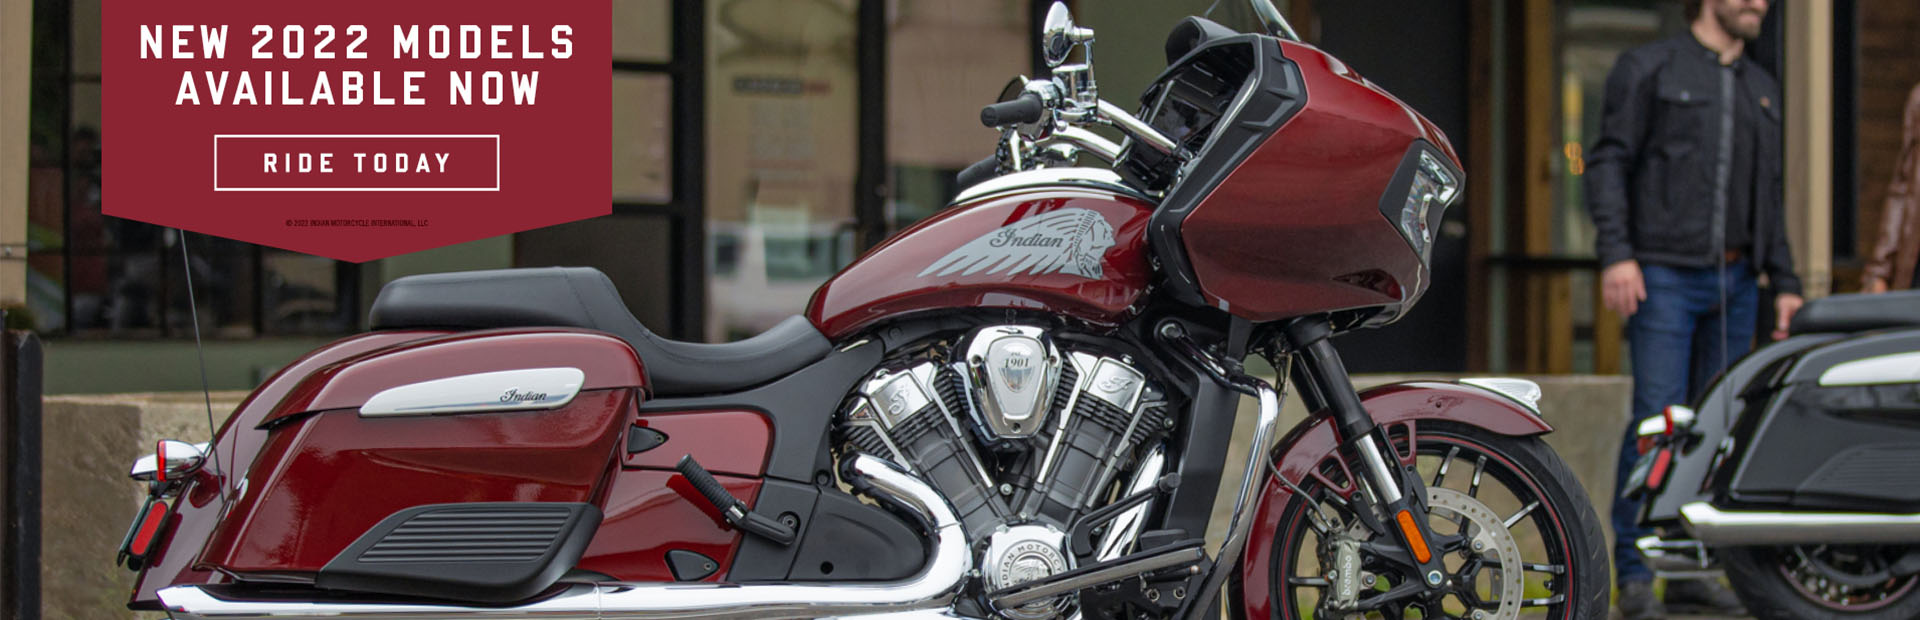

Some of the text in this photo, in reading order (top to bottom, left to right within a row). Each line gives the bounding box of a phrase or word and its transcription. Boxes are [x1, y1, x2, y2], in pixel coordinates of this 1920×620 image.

[989, 228, 1064, 248] Indian
[1004, 357, 1029, 369] 1901
[500, 388, 547, 402] Indian
